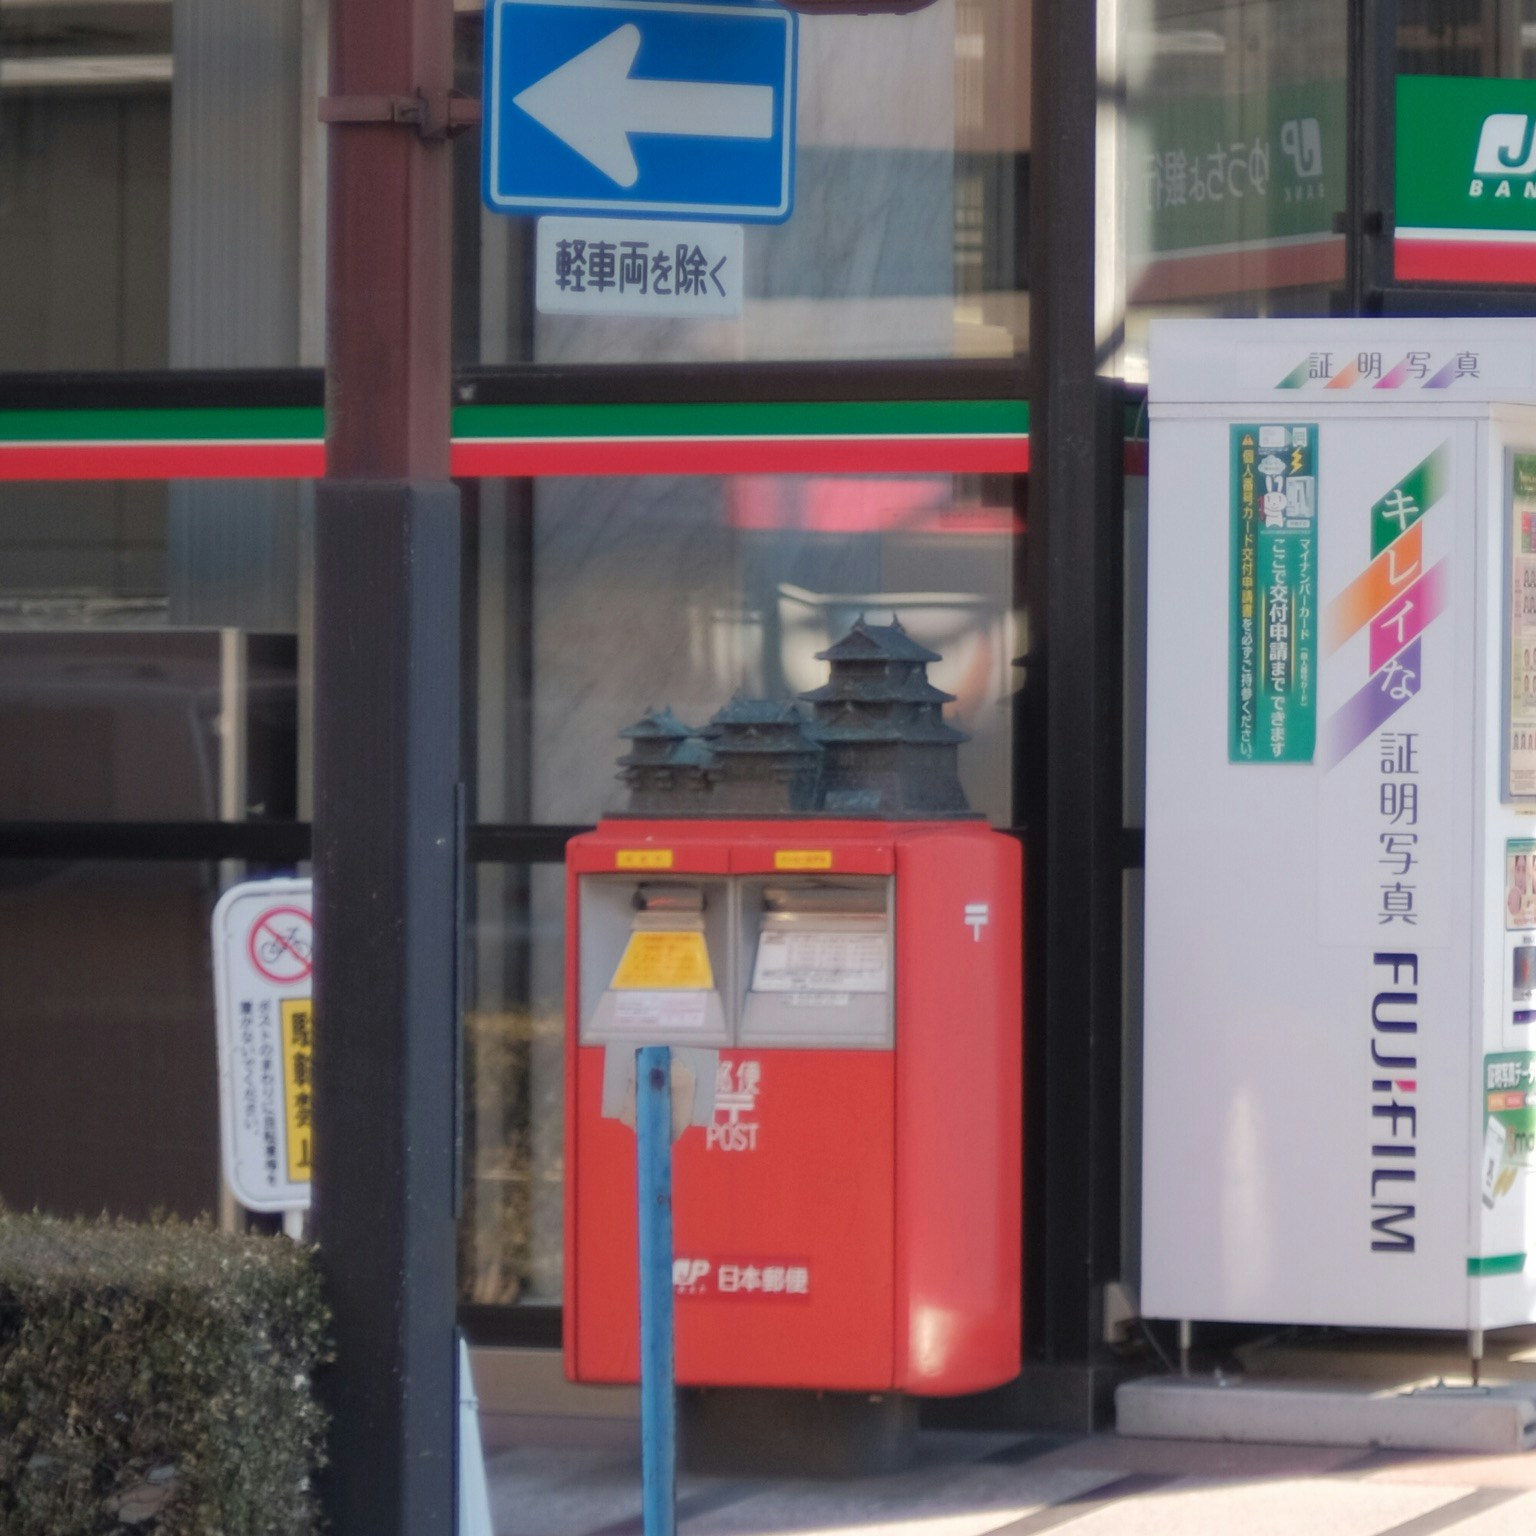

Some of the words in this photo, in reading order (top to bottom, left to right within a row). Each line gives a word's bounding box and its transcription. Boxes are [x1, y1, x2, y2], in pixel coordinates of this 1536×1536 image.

[555, 239, 728, 298] 軽車両を除く
[1309, 351, 1480, 379] 証明写真
[1299, 538, 1311, 640] マイナンバーカード
[1380, 489, 1418, 700] キレイな
[1378, 732, 1419, 926] 証明写真
[705, 1123, 760, 1152] POST
[1370, 952, 1419, 1253] FUJIFILM
[718, 1265, 809, 1294] 日本郵便
